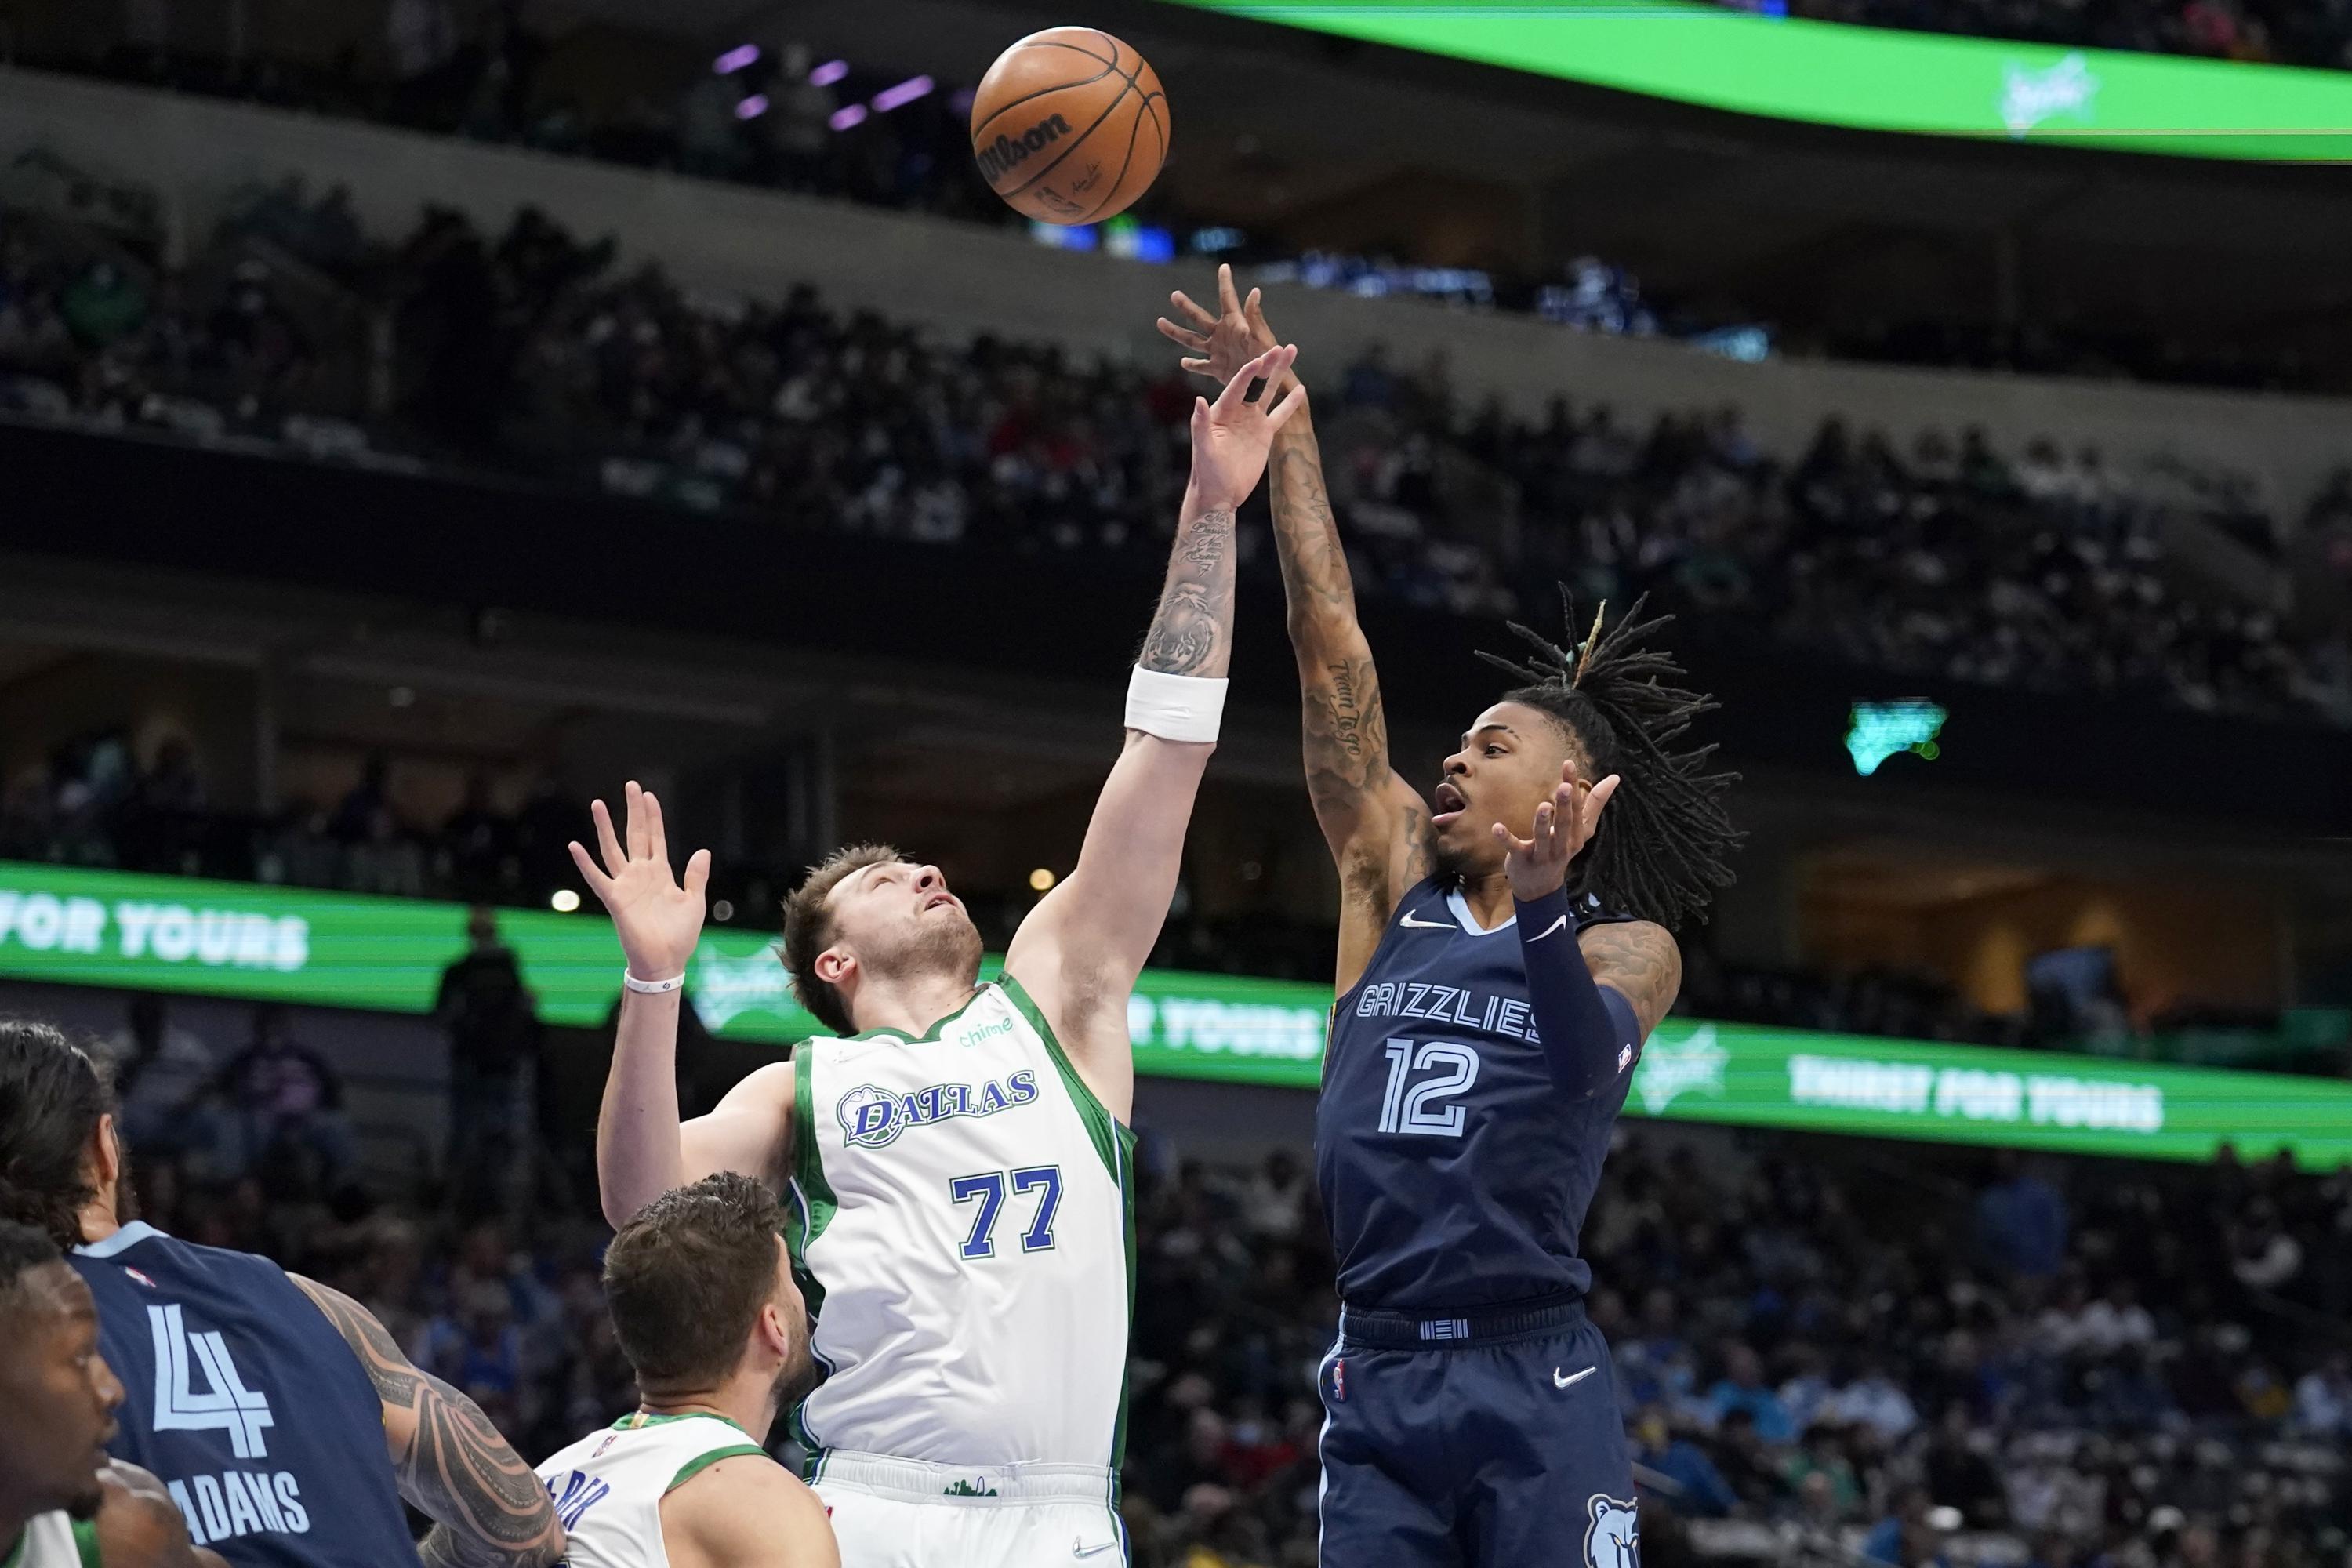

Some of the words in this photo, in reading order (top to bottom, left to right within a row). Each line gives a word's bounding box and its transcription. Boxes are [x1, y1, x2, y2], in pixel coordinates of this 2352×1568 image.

[116, 899, 309, 971] YOURS
[960, 1017, 1013, 1047] chime
[847, 1070, 1039, 1140] DALLAS
[1377, 1038, 1480, 1138] 12
[949, 1164, 1064, 1261] 77
[146, 1303, 274, 1458] 4
